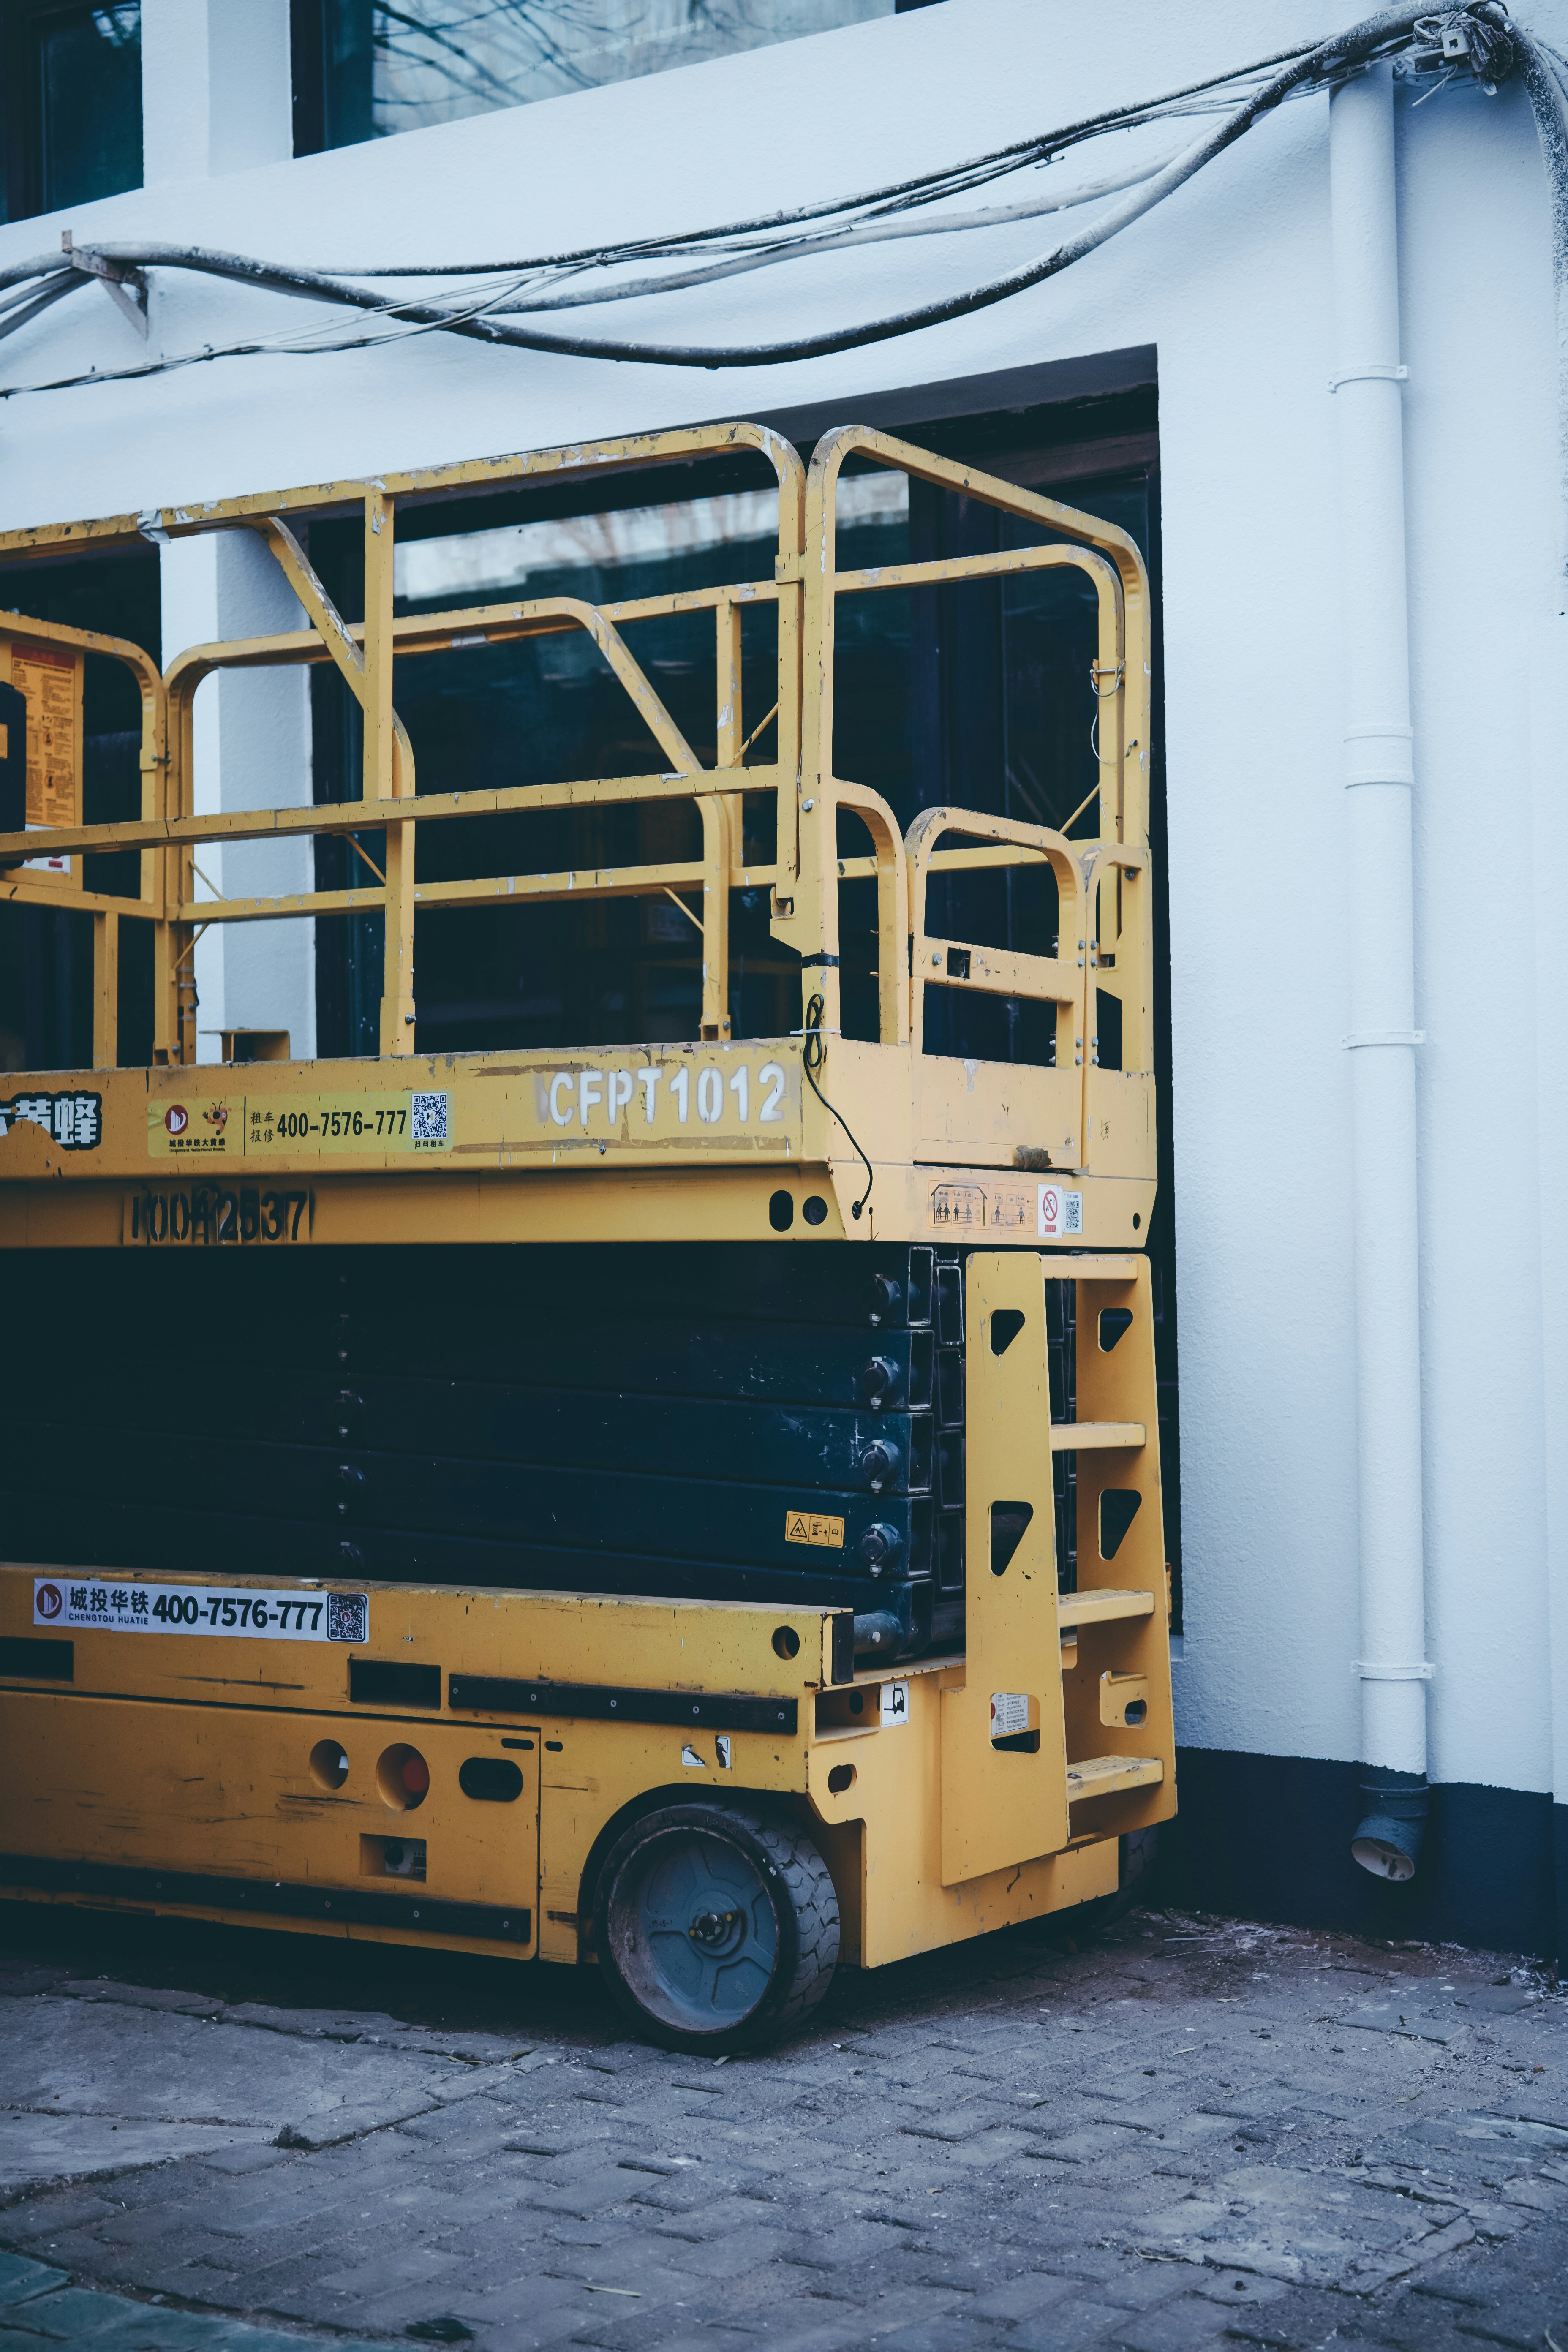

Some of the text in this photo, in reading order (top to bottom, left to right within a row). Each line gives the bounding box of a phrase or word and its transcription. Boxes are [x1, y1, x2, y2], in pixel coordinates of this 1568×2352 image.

[550, 1063, 785, 1126] CFPT1012
[250, 1111, 274, 1125] 租车
[277, 1110, 406, 1137] 400-7576-777
[169, 1138, 225, 1147] 城投华铁大黄蜂
[250, 1129, 275, 1143] 报修
[415, 1140, 444, 1149] 扫码租车
[69, 1586, 149, 1614] 城投华铁
[68, 1613, 148, 1625] CHENGTOU HUATIE
[152, 1595, 323, 1631] 400-7576-777
